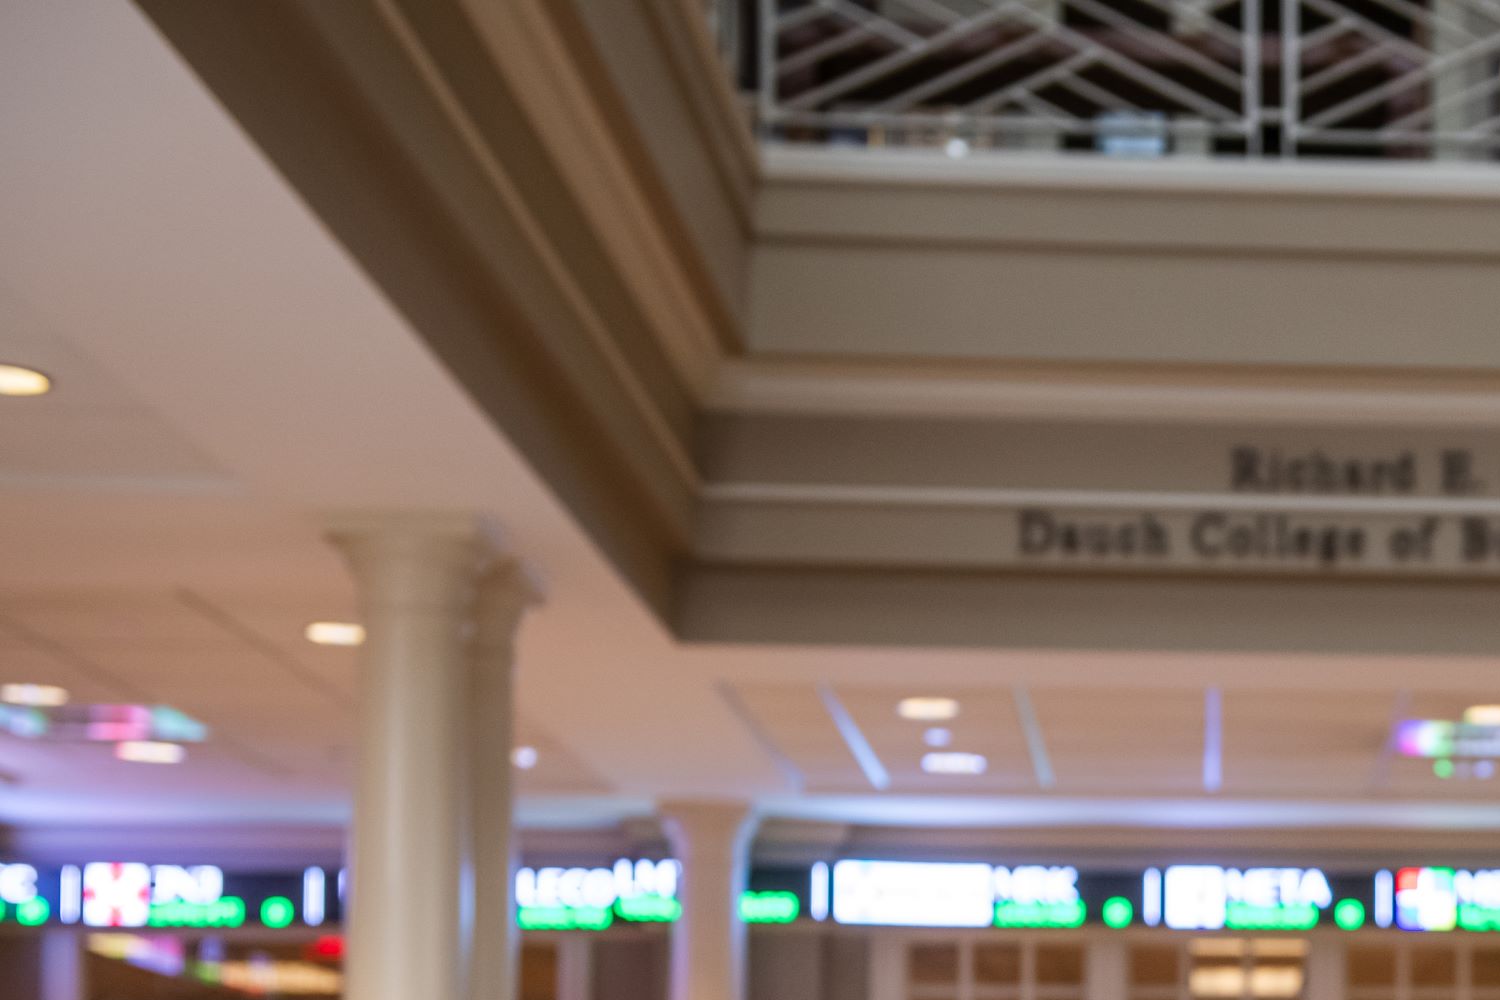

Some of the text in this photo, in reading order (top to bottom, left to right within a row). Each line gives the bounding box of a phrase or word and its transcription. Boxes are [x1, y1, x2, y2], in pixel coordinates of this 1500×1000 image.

[1231, 446, 1416, 493] Richard
[1018, 509, 1168, 554] Dauch
[1191, 512, 1365, 564] College
[1388, 517, 1438, 559] of
